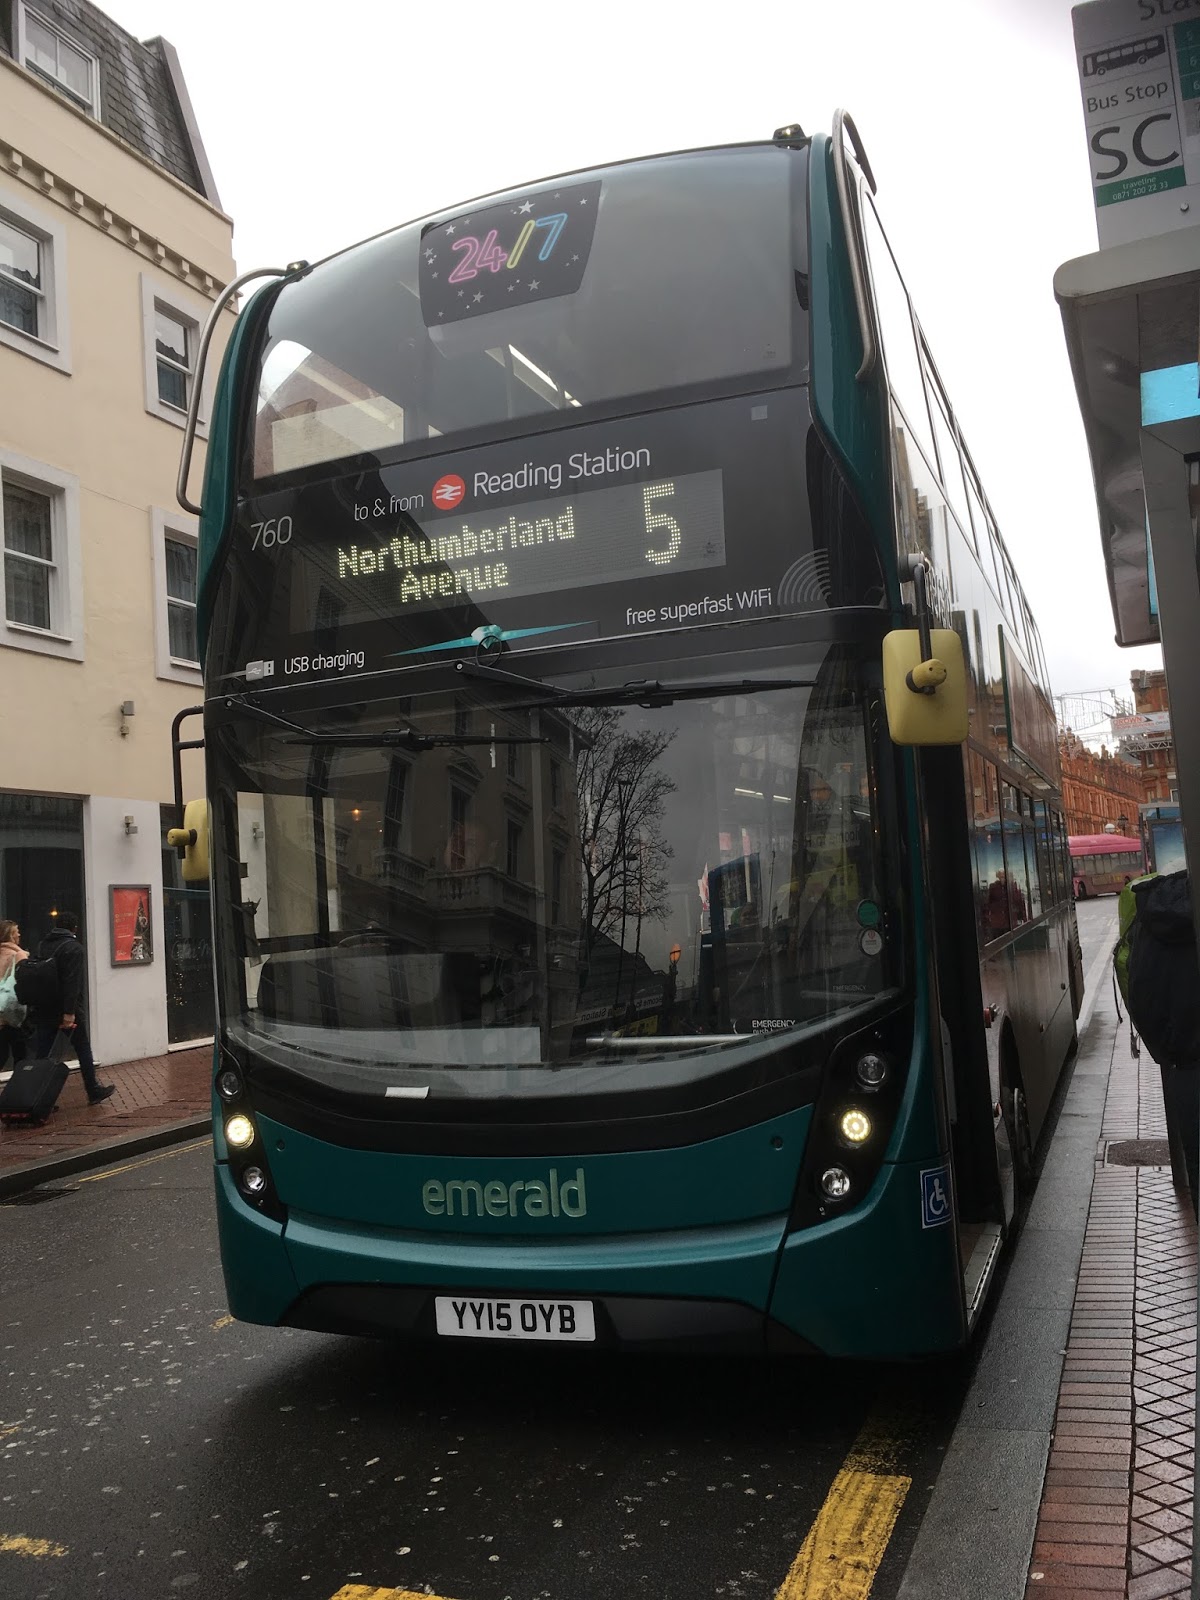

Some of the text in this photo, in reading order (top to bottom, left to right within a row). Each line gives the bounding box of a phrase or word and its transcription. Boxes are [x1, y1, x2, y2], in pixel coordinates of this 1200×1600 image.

[1087, 81, 1168, 113] Bus Stop
[1091, 113, 1179, 180] SC
[1112, 180, 1169, 201] 0871 200 22 33
[1122, 177, 1157, 190] traveline
[448, 213, 568, 283] 24/7
[354, 447, 651, 521] to & from Reading Station
[250, 515, 293, 551] 760
[337, 506, 576, 578] Northumberland
[642, 482, 682, 565] 5
[400, 562, 509, 603] Avenue
[626, 588, 772, 625] free superfast WiFi
[284, 650, 366, 675] USB charging
[752, 1019, 796, 1028] EMERGENCY
[422, 1167, 587, 1218] emerald
[452, 1301, 576, 1334] YY15 OYB
